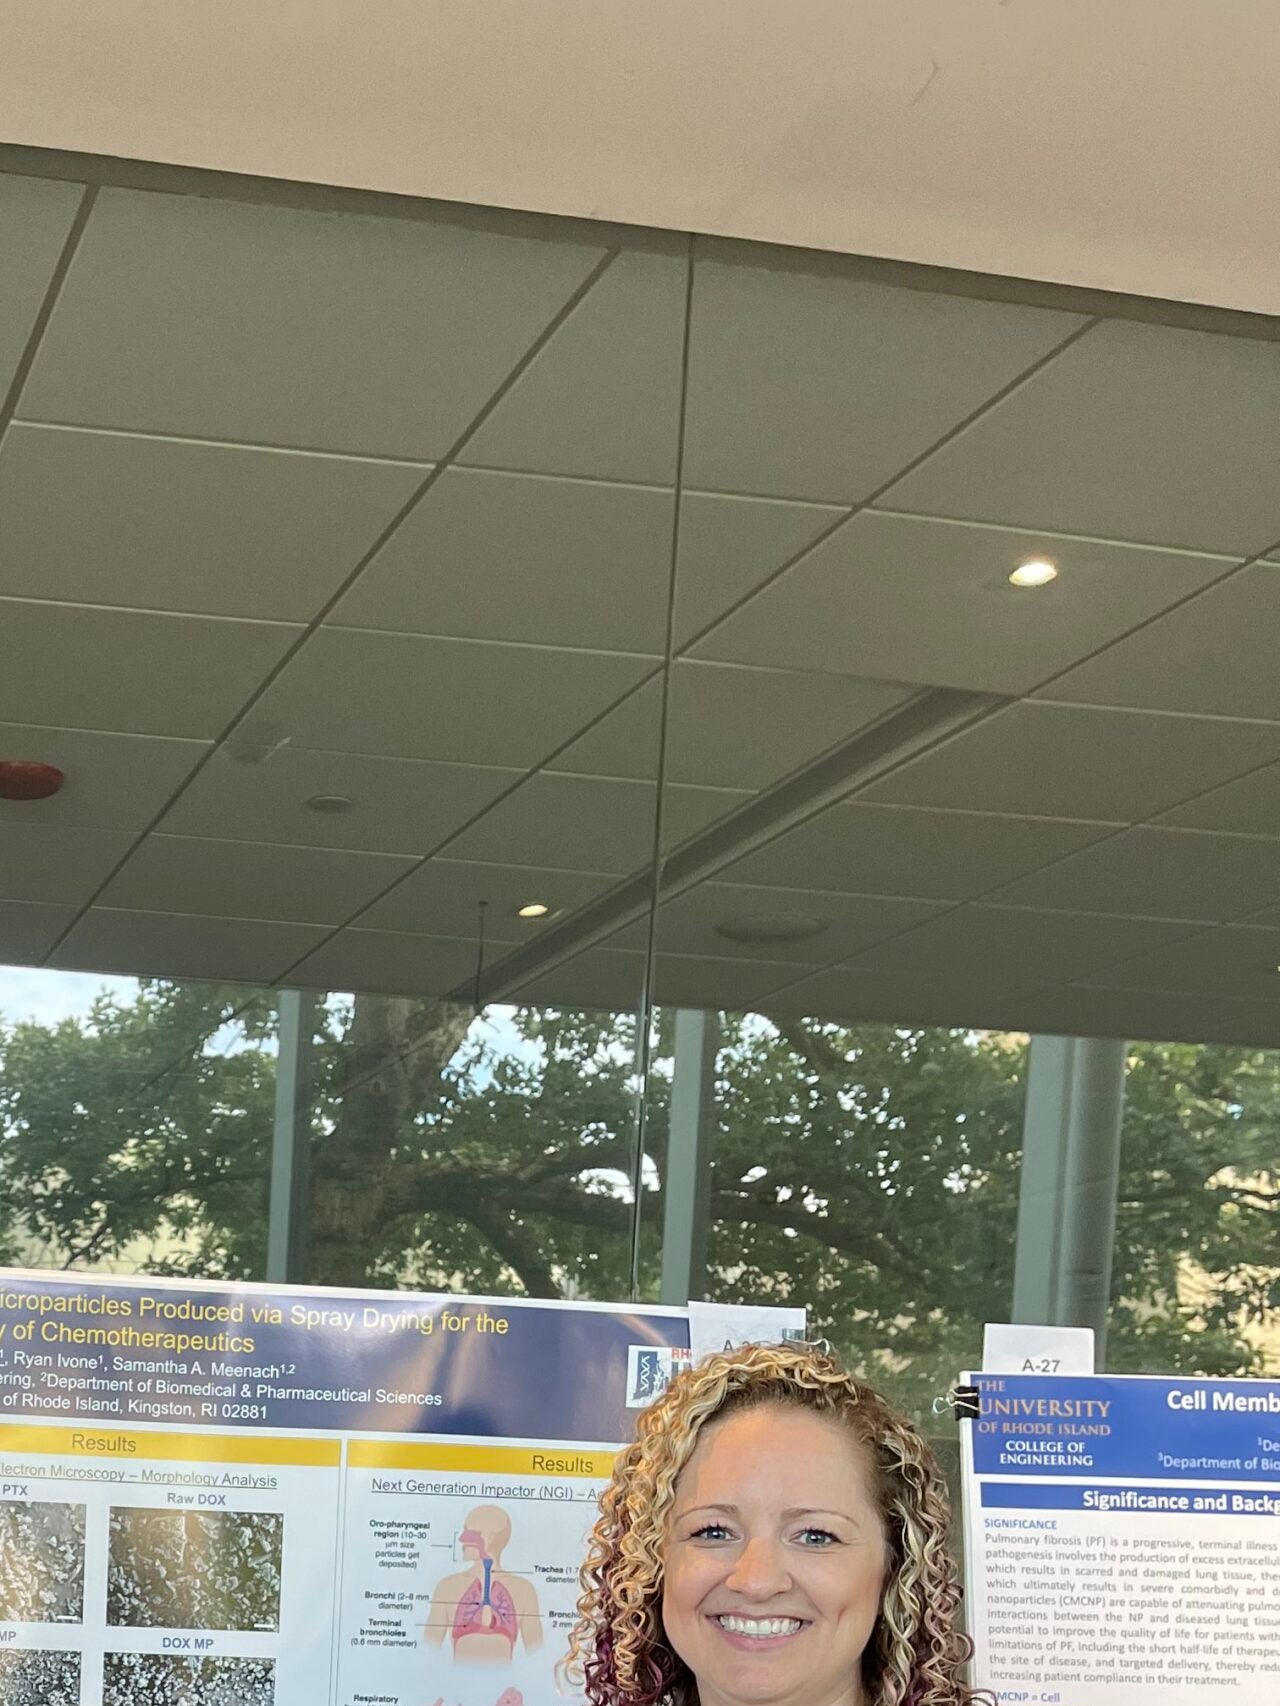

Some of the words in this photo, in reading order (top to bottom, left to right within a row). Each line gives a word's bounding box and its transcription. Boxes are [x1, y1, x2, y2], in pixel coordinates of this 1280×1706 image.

[139, 1297, 243, 1323] Produced
[252, 1305, 282, 1325] via
[290, 1305, 355, 1331] Spray
[363, 1308, 433, 1335] Drying
[441, 1311, 470, 1332] for
[476, 1312, 509, 1334] the
[12, 1318, 36, 1341] of
[40, 1320, 255, 1357] Chemotherapeutics
[13, 1350, 53, 1370] Ryan
[112, 1356, 188, 1373] Samantha
[190, 1360, 206, 1374] A.
[1021, 1359, 1060, 1373] A-27
[136, 1378, 153, 1392] of
[155, 1379, 236, 1396] Biomedical
[239, 1383, 252, 1397] &
[255, 1383, 371, 1403] Pharmaceutical
[374, 1388, 443, 1406] Sciences
[1167, 1390, 1207, 1411] Cell
[2, 1391, 19, 1406] of
[21, 1392, 71, 1409] Rhode
[75, 1396, 124, 1414] Island,
[127, 1398, 196, 1419] Kingston,
[200, 1402, 218, 1417] RI
[221, 1403, 267, 1420] 02881
[980, 1398, 1111, 1418] UNIVERSITY
[979, 1422, 997, 1433] OF
[1003, 1422, 1053, 1435] RHODE
[1059, 1424, 1111, 1436] ISLAND
[71, 1433, 137, 1452] Results
[1006, 1440, 1064, 1452] COLLEGE
[1068, 1441, 1086, 1453] OF
[531, 1454, 594, 1473] Results
[1000, 1453, 1093, 1466] ENGINEERING
[49, 1464, 126, 1484] Microscopy
[141, 1469, 220, 1488] Morphology
[220, 1472, 278, 1490] Analysis
[1, 1483, 28, 1496] PTX
[166, 1492, 195, 1504] Raw
[197, 1493, 227, 1506] DOX
[371, 1478, 403, 1492] Next
[405, 1479, 477, 1495] Generation
[480, 1483, 536, 1500] Impactor
[538, 1485, 573, 1502] (NGI)
[1083, 1491, 1189, 1511] Significance
[1194, 1497, 1227, 1510] and
[984, 1518, 1057, 1530] SIGNIFICANCE
[161, 1637, 191, 1649] DOX
[193, 1638, 214, 1649] MP
